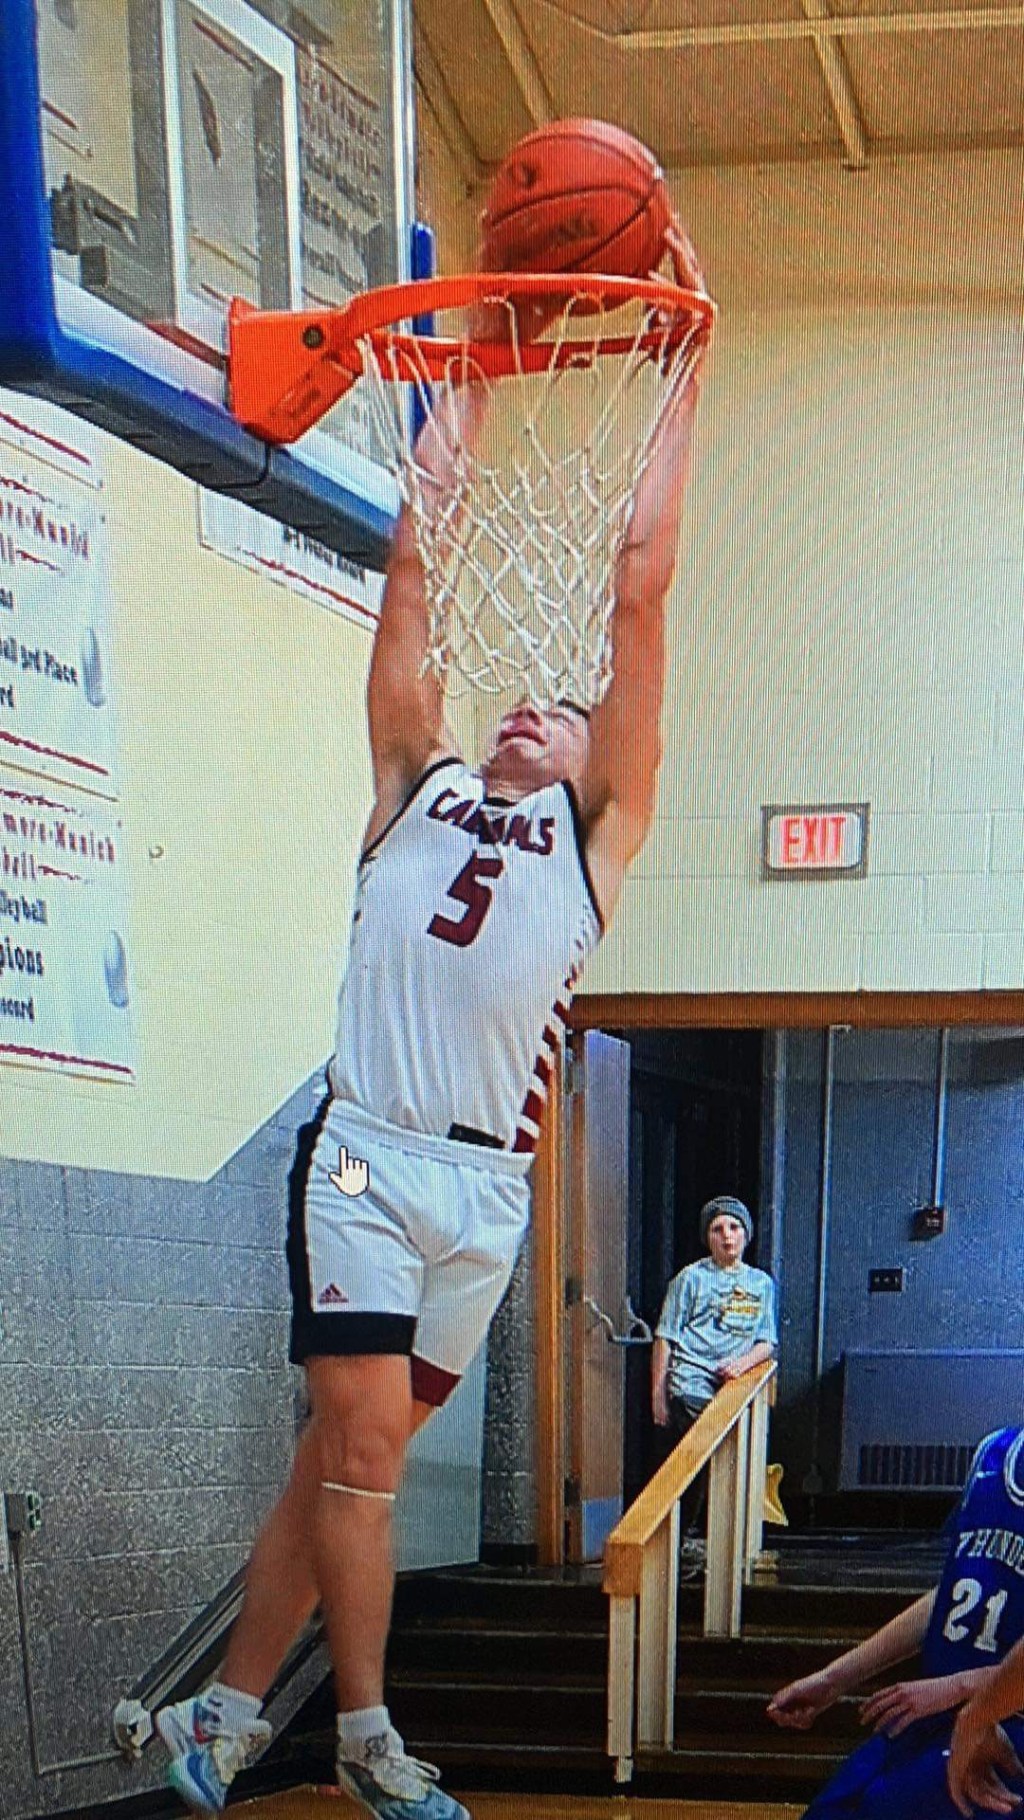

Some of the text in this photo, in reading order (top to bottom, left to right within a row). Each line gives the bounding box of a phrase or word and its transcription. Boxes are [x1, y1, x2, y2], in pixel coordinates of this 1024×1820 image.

[782, 816, 846, 863] EXIT
[427, 848, 504, 947] 5
[943, 1577, 1008, 1653] 21
